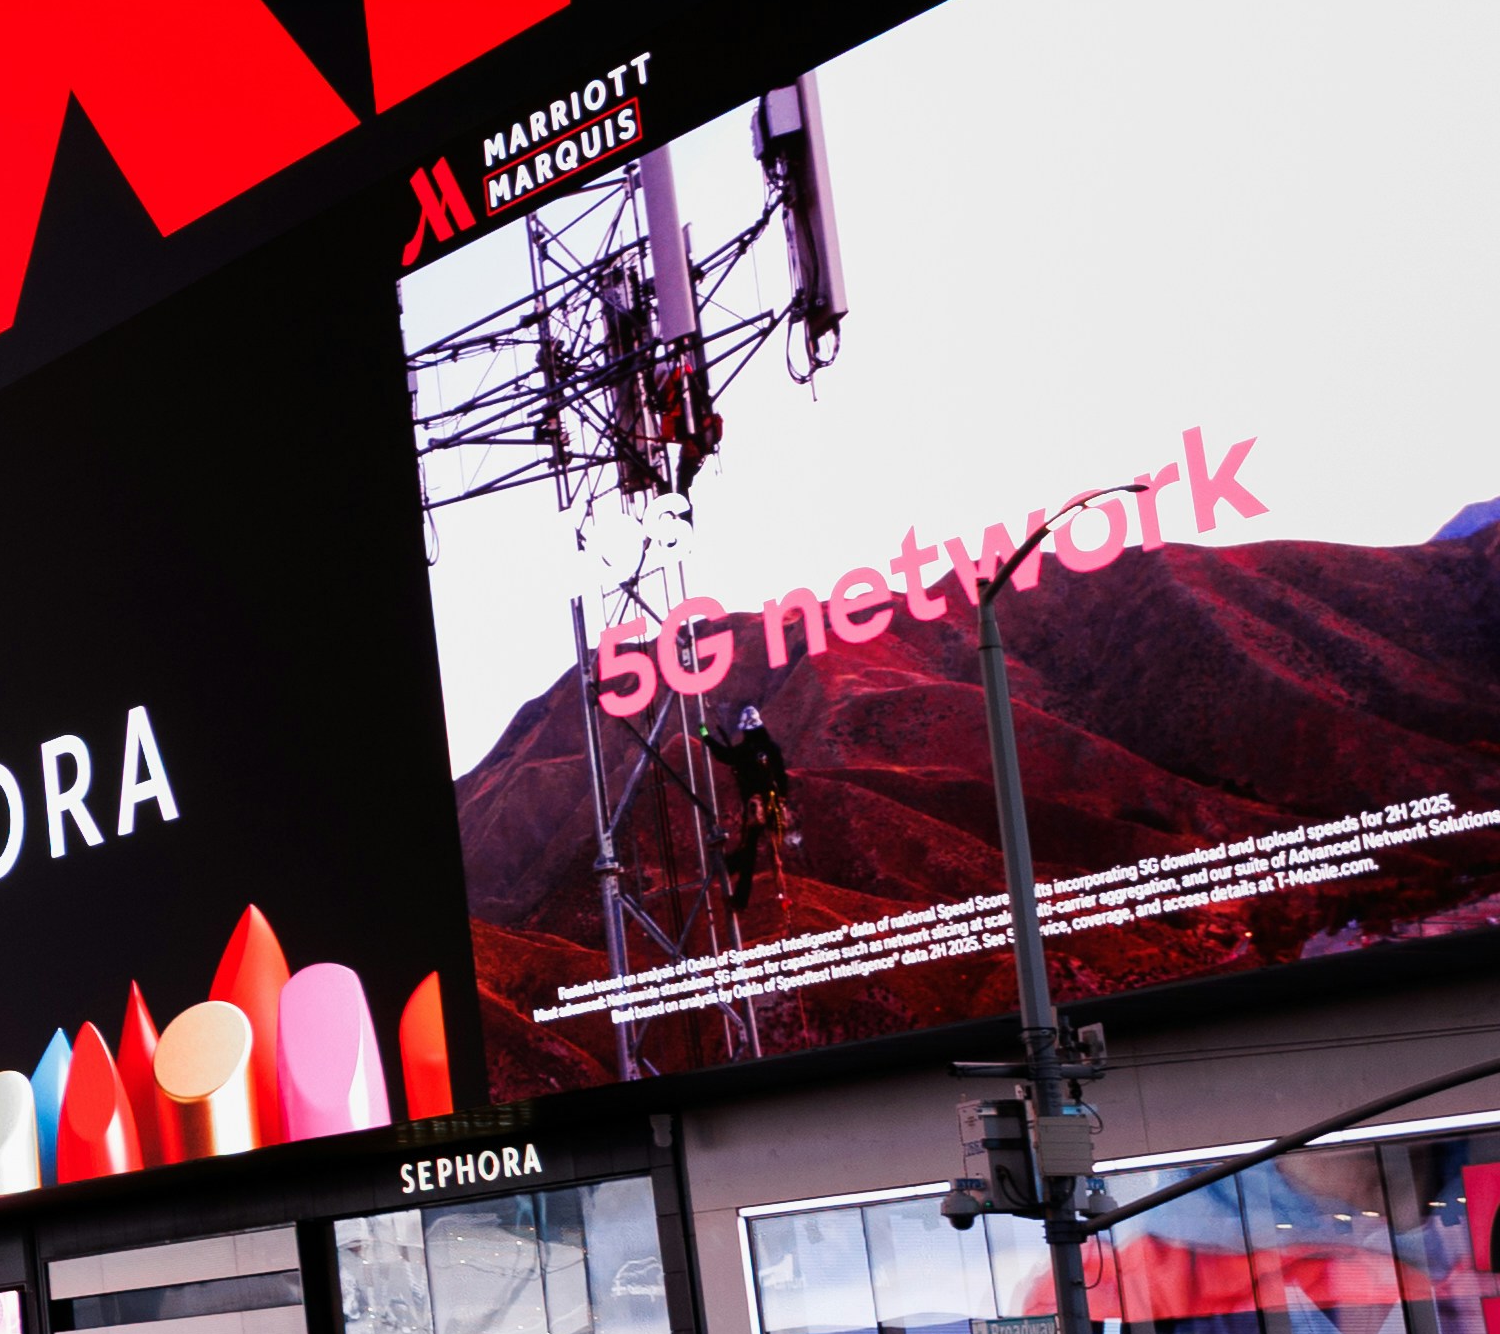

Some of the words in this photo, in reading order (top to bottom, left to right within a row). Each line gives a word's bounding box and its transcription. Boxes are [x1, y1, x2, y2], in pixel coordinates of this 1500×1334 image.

[483, 51, 650, 167] MARRIOTT
[489, 108, 636, 207] MARQUIS
[598, 596, 734, 717] 5G
[764, 426, 1270, 668] network
[1138, 857, 1159, 875] 5G
[1161, 842, 1226, 869] download
[1228, 837, 1256, 857] and
[1256, 825, 1305, 852] upload
[1307, 816, 1359, 840] speeds
[1360, 811, 1383, 828] for
[1384, 803, 1407, 823] 2H
[1409, 793, 1455, 818] 2025.
[1181, 870, 1208, 887] and
[1210, 866, 1233, 882] our
[1235, 857, 1269, 875] suite
[1289, 836, 1361, 864] Advanced
[1362, 824, 1427, 849] Network
[1429, 810, 1500, 836] Solutions
[1072, 906, 1134, 931] coverage,
[1136, 899, 1161, 917] and
[1163, 891, 1209, 912] access
[1210, 880, 1256, 902] details
[1275, 858, 1379, 889] T-Mobile.com.
[400, 1144, 542, 1194] SEPHORA
